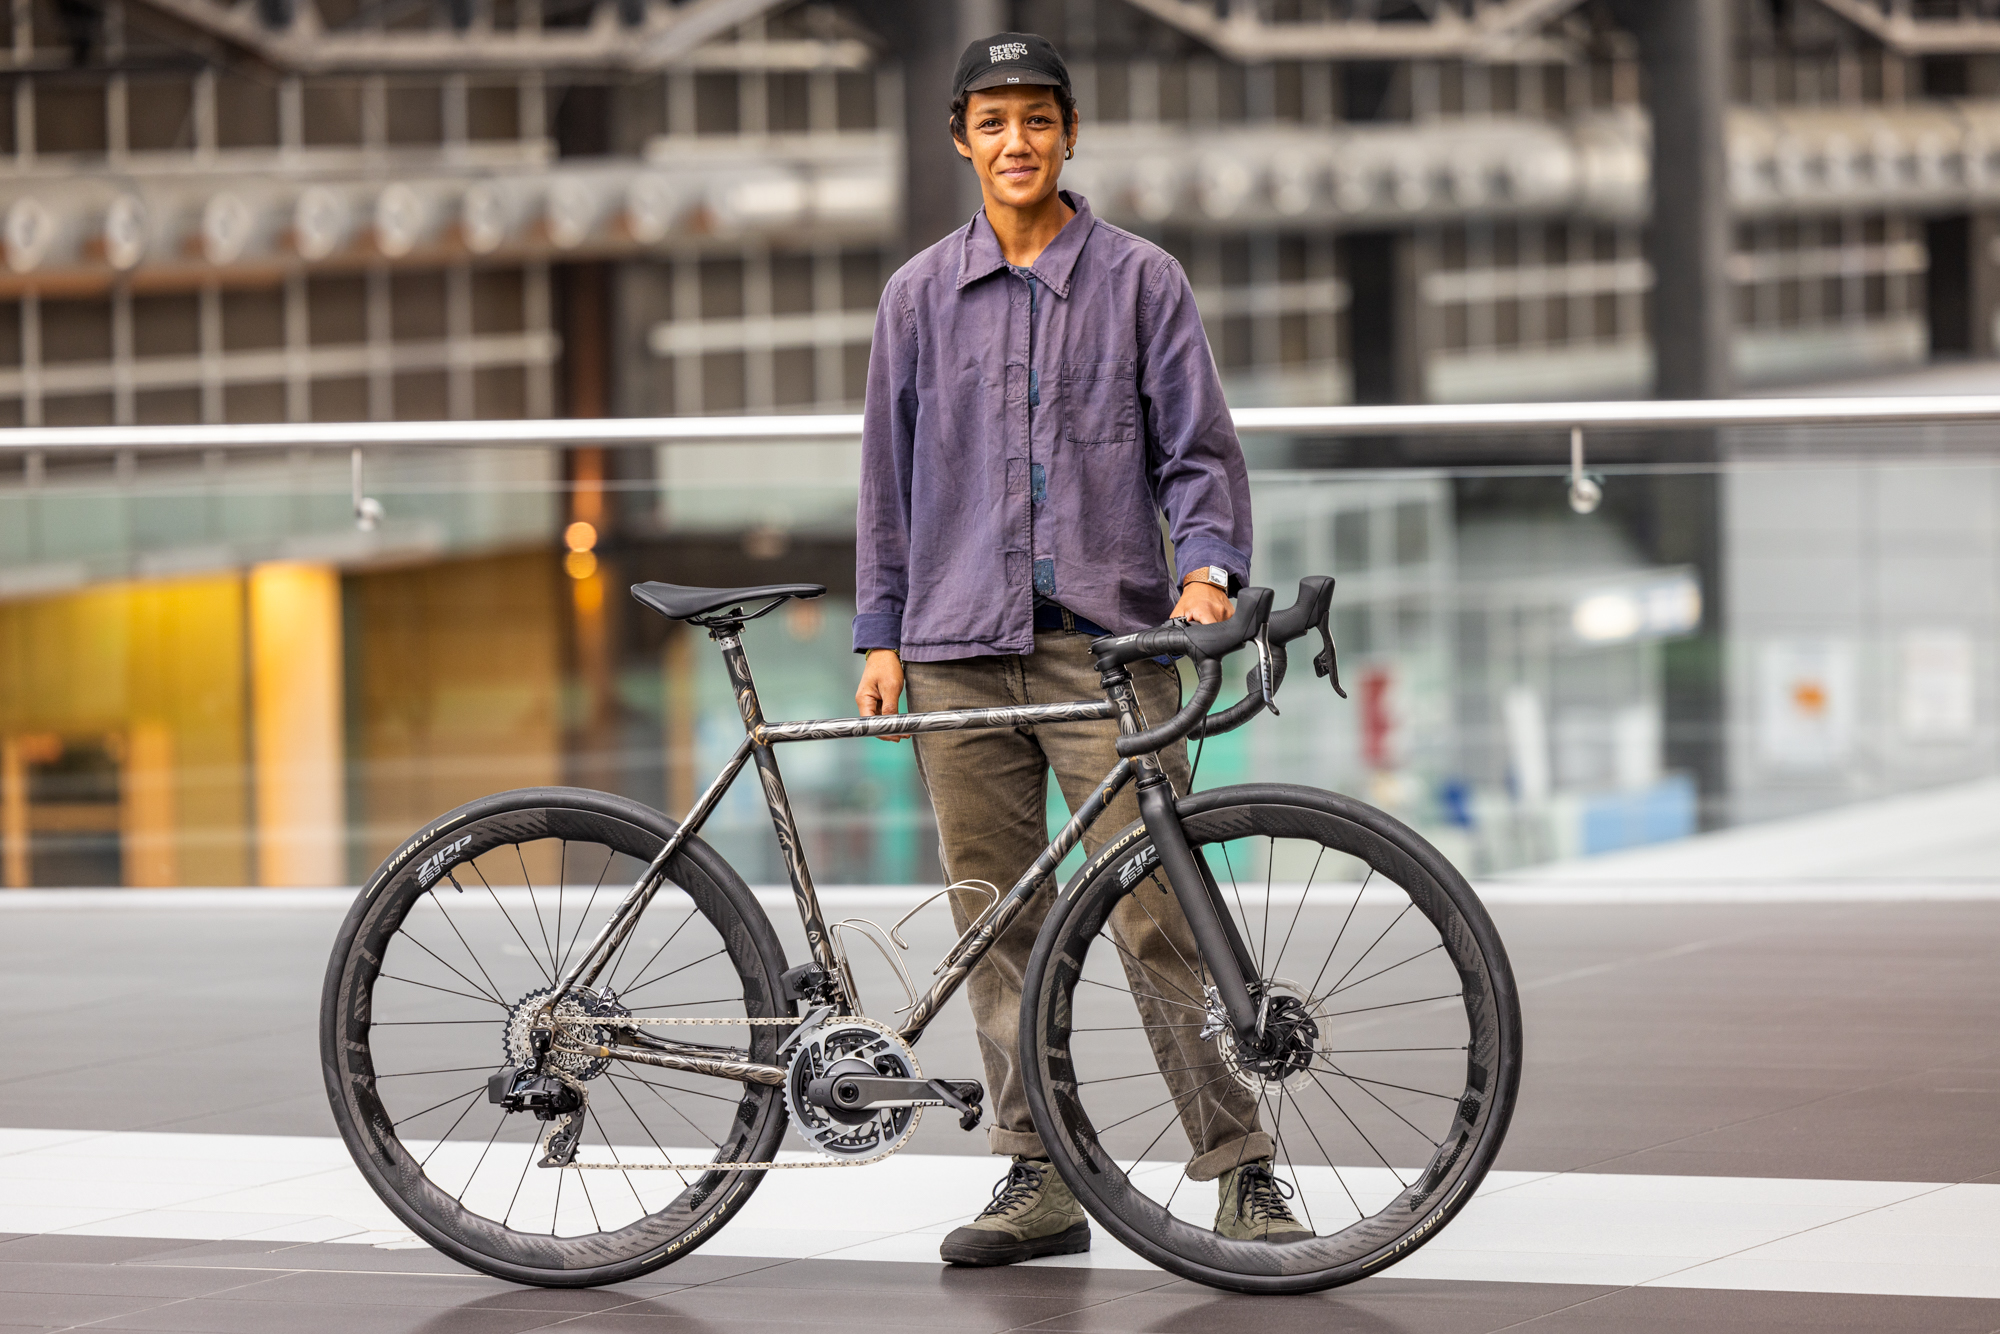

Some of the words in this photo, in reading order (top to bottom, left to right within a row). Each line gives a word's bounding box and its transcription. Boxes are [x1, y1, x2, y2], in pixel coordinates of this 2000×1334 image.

[989, 48, 1028, 56] CLEWO
[388, 829, 435, 872] PIRELLI
[415, 834, 472, 880] ZIPP
[1085, 866, 1094, 879] P
[1094, 835, 1130, 868] ZERO
[1117, 844, 1156, 881] ZIP
[419, 864, 442, 888] 353
[1120, 865, 1144, 889] 353
[718, 1202, 726, 1215] P
[683, 1212, 717, 1244] ZERO
[1395, 1208, 1444, 1253] PIRELLI
